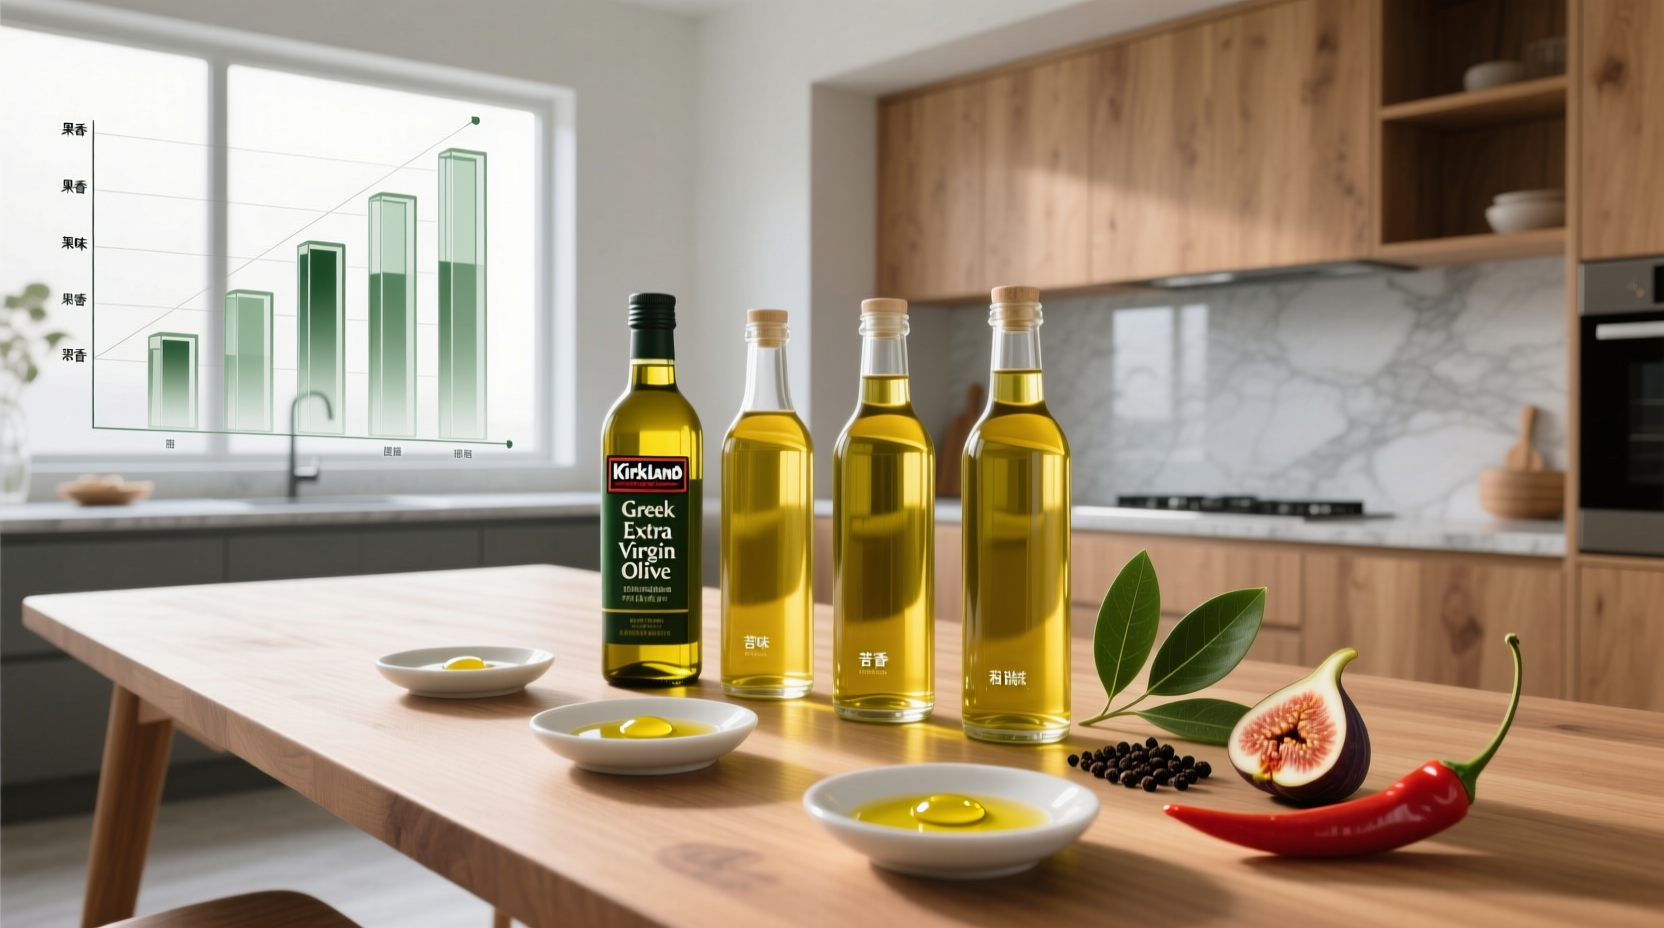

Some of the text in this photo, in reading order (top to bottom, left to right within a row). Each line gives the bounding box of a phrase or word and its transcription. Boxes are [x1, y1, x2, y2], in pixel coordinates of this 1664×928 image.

[621, 500, 676, 518] Greek
[623, 521, 672, 539] Extra
[618, 541, 676, 563] Virgin
[621, 561, 671, 579] Olive
